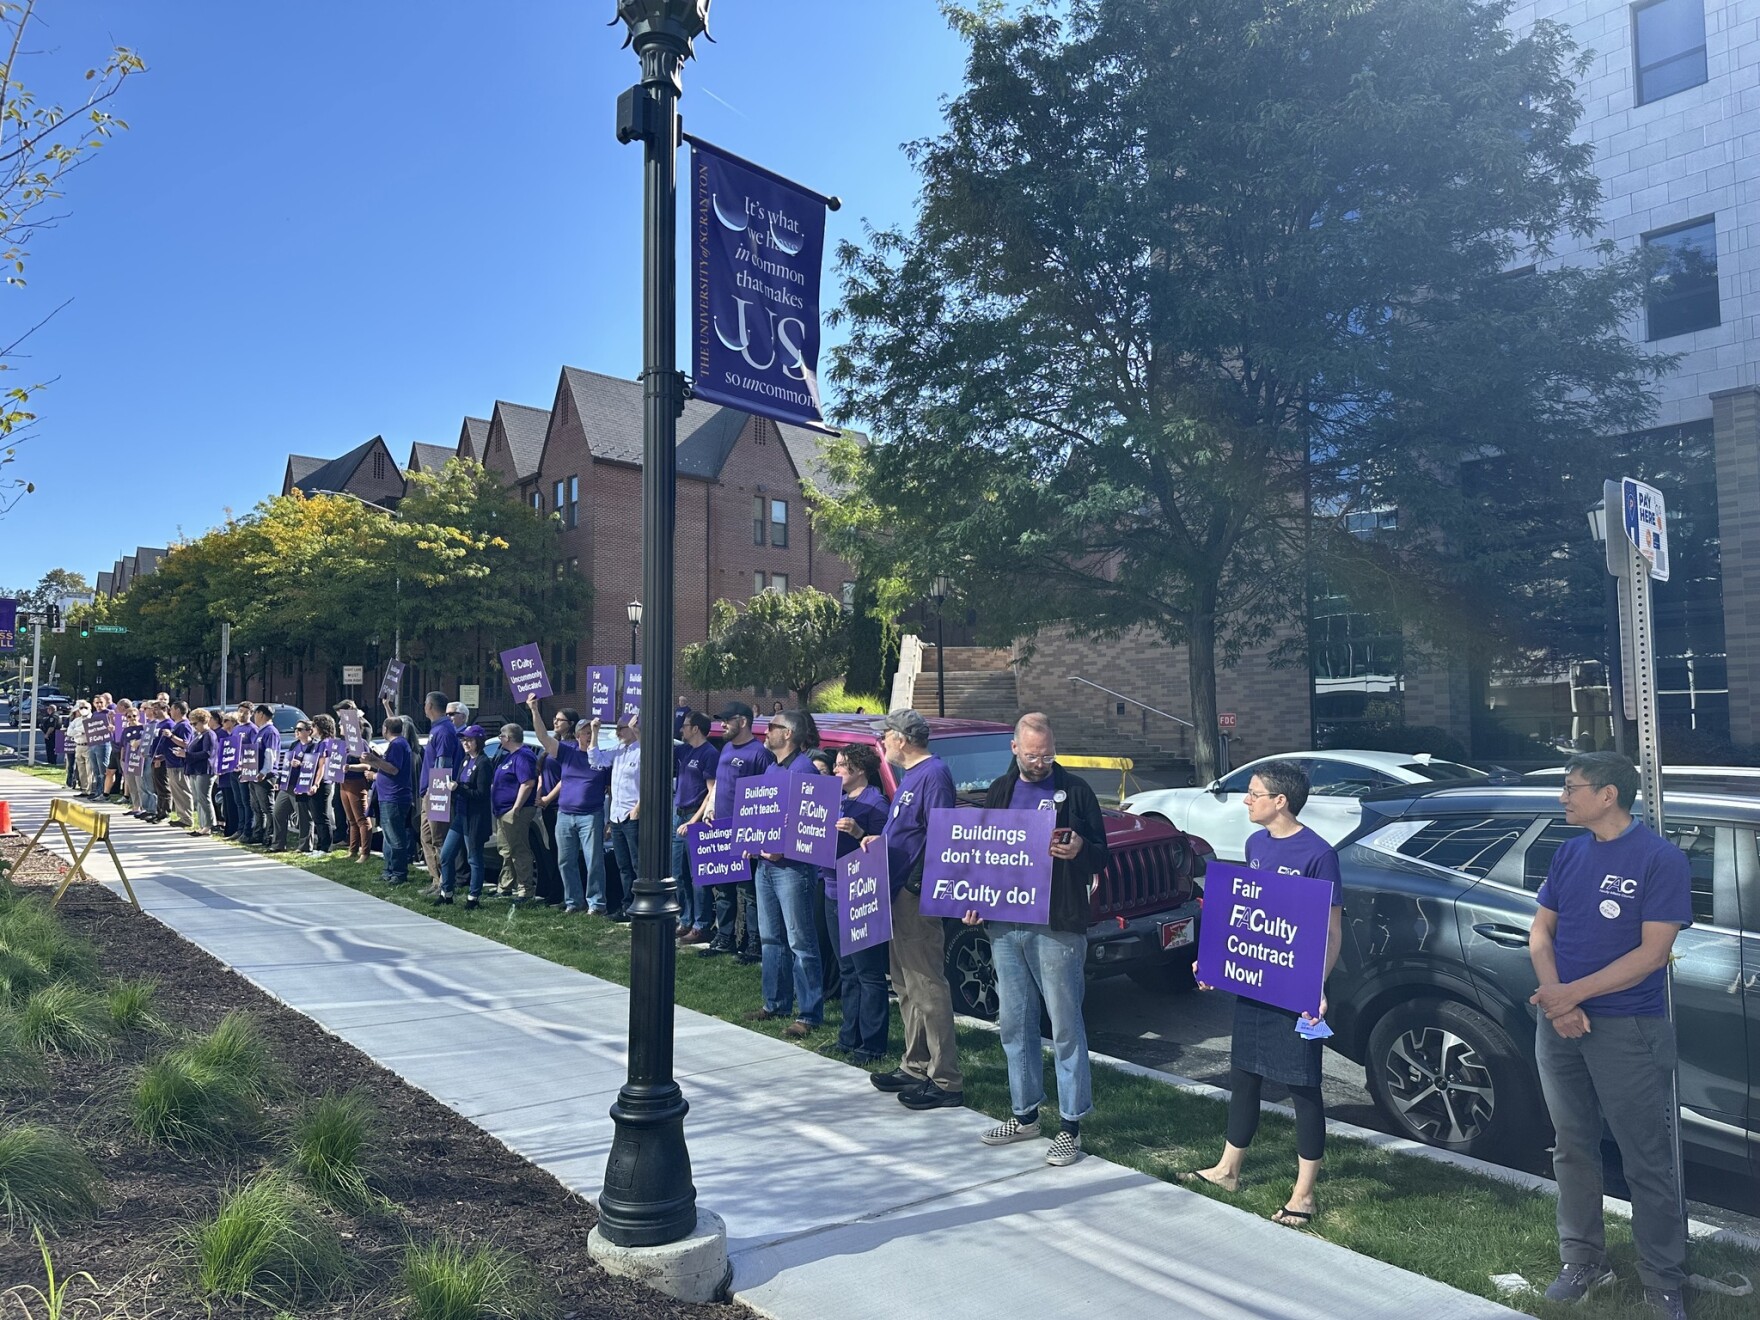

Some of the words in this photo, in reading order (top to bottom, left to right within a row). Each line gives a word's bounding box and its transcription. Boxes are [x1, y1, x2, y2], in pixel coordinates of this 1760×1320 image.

[699, 163, 709, 243] SCRANTON
[767, 210, 799, 233] what
[747, 227, 763, 245] we
[735, 243, 750, 261] in
[751, 255, 804, 285] common
[736, 270, 763, 293] that
[764, 285, 803, 309] makes
[699, 258, 710, 344] UNIVERSITY
[731, 295, 806, 381] US
[699, 347, 710, 377] THE
[725, 371, 740, 386] so
[1639, 492, 1652, 510] PAY
[1640, 509, 1656, 526] HERE
[510, 669, 542, 684] Uncommonly
[517, 680, 542, 693] Dedicated
[1220, 716, 1234, 724] FDC
[745, 785, 778, 799] Buildings
[801, 781, 815, 796] Fair
[740, 803, 758, 816] don't
[759, 801, 780, 815] teach.
[1037, 799, 1056, 810] FA
[768, 826, 781, 841] do!
[797, 821, 826, 839] Contract
[951, 824, 1027, 846] Buildings
[697, 843, 717, 855] don't
[795, 839, 813, 854] Now!
[730, 860, 744, 872] do!
[940, 848, 981, 864] don't
[985, 850, 1034, 867] teach.
[847, 859, 861, 877] Fair
[932, 879, 1001, 907] FACulty
[1006, 886, 1036, 906] do!
[1232, 877, 1263, 900] Fair
[1599, 874, 1637, 894] FAC
[850, 898, 879, 922] Contract
[850, 922, 868, 943] Now!
[1229, 904, 1298, 945] FACulty
[1227, 935, 1295, 968] Contract
[1224, 960, 1263, 987] Now!
